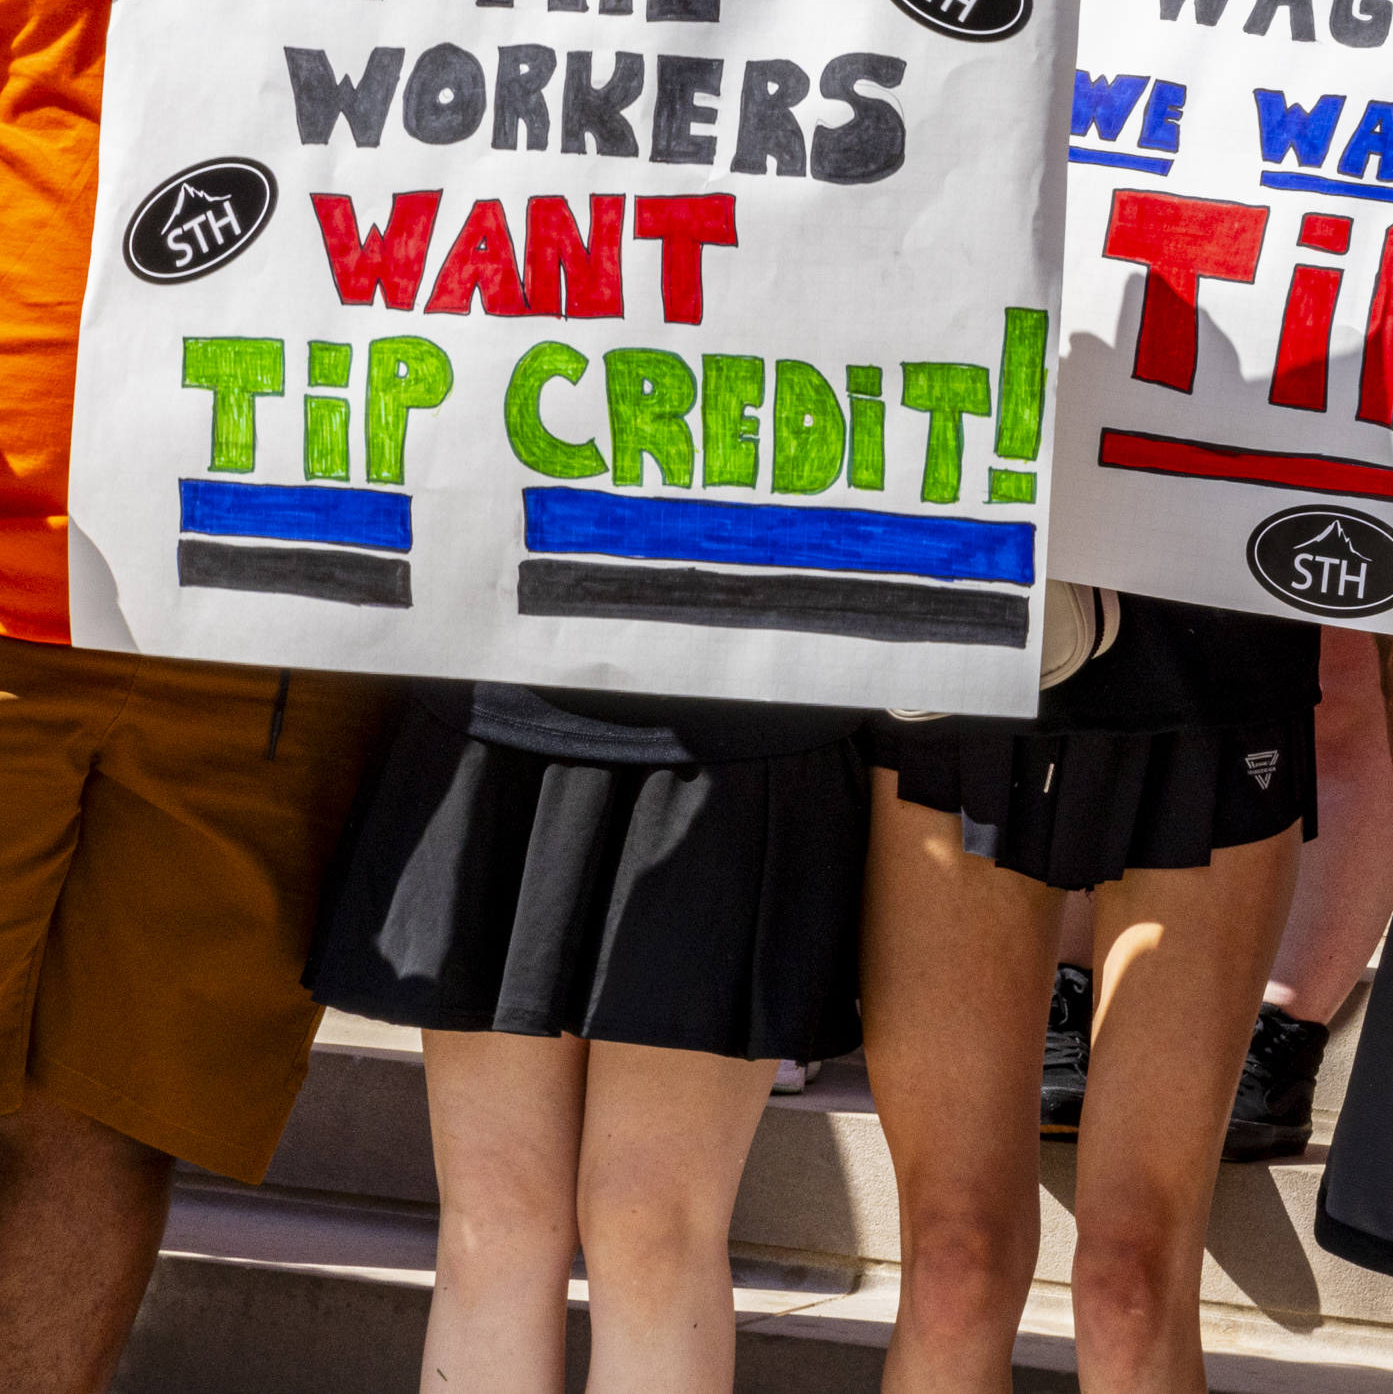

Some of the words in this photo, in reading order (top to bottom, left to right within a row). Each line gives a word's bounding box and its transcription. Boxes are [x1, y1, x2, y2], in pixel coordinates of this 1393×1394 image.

[284, 42, 907, 186] WORKERS
[1069, 68, 1187, 152] WE
[166, 200, 241, 268] STH
[309, 189, 739, 326] WANT
[1291, 552, 1368, 600] STH
